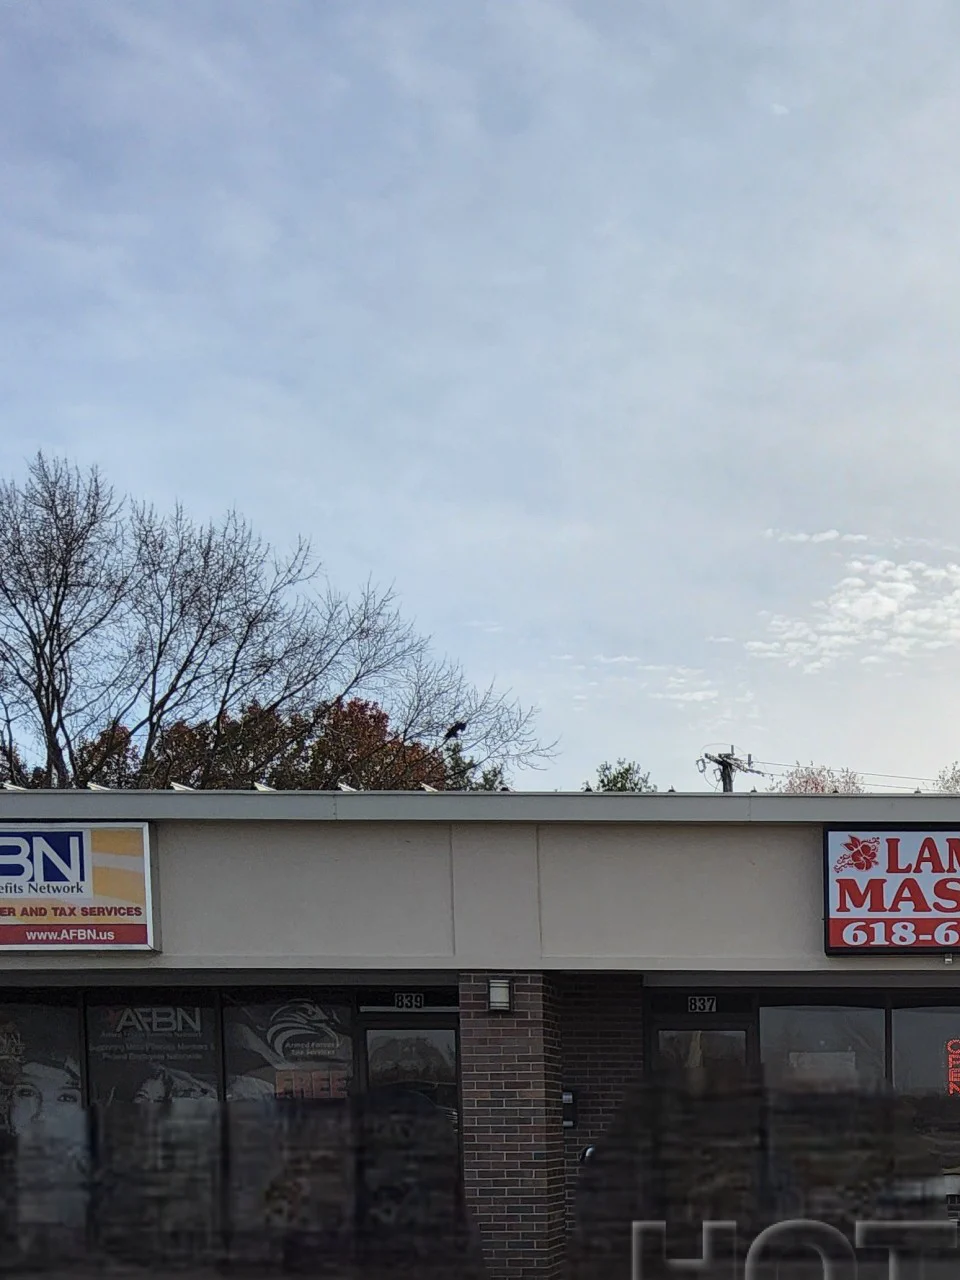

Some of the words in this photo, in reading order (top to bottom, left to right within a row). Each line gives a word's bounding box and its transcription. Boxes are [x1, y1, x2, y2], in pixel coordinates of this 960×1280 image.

[28, 882, 84, 894] Network
[20, 907, 48, 917] AND
[52, 907, 77, 917] TAX
[81, 907, 143, 917] SERVICES
[25, 928, 115, 940] www.AFBN.us
[395, 994, 423, 1009] 839
[689, 997, 716, 1011] 837
[115, 1007, 202, 1033] AFBN
[275, 1070, 349, 1099] FREE
